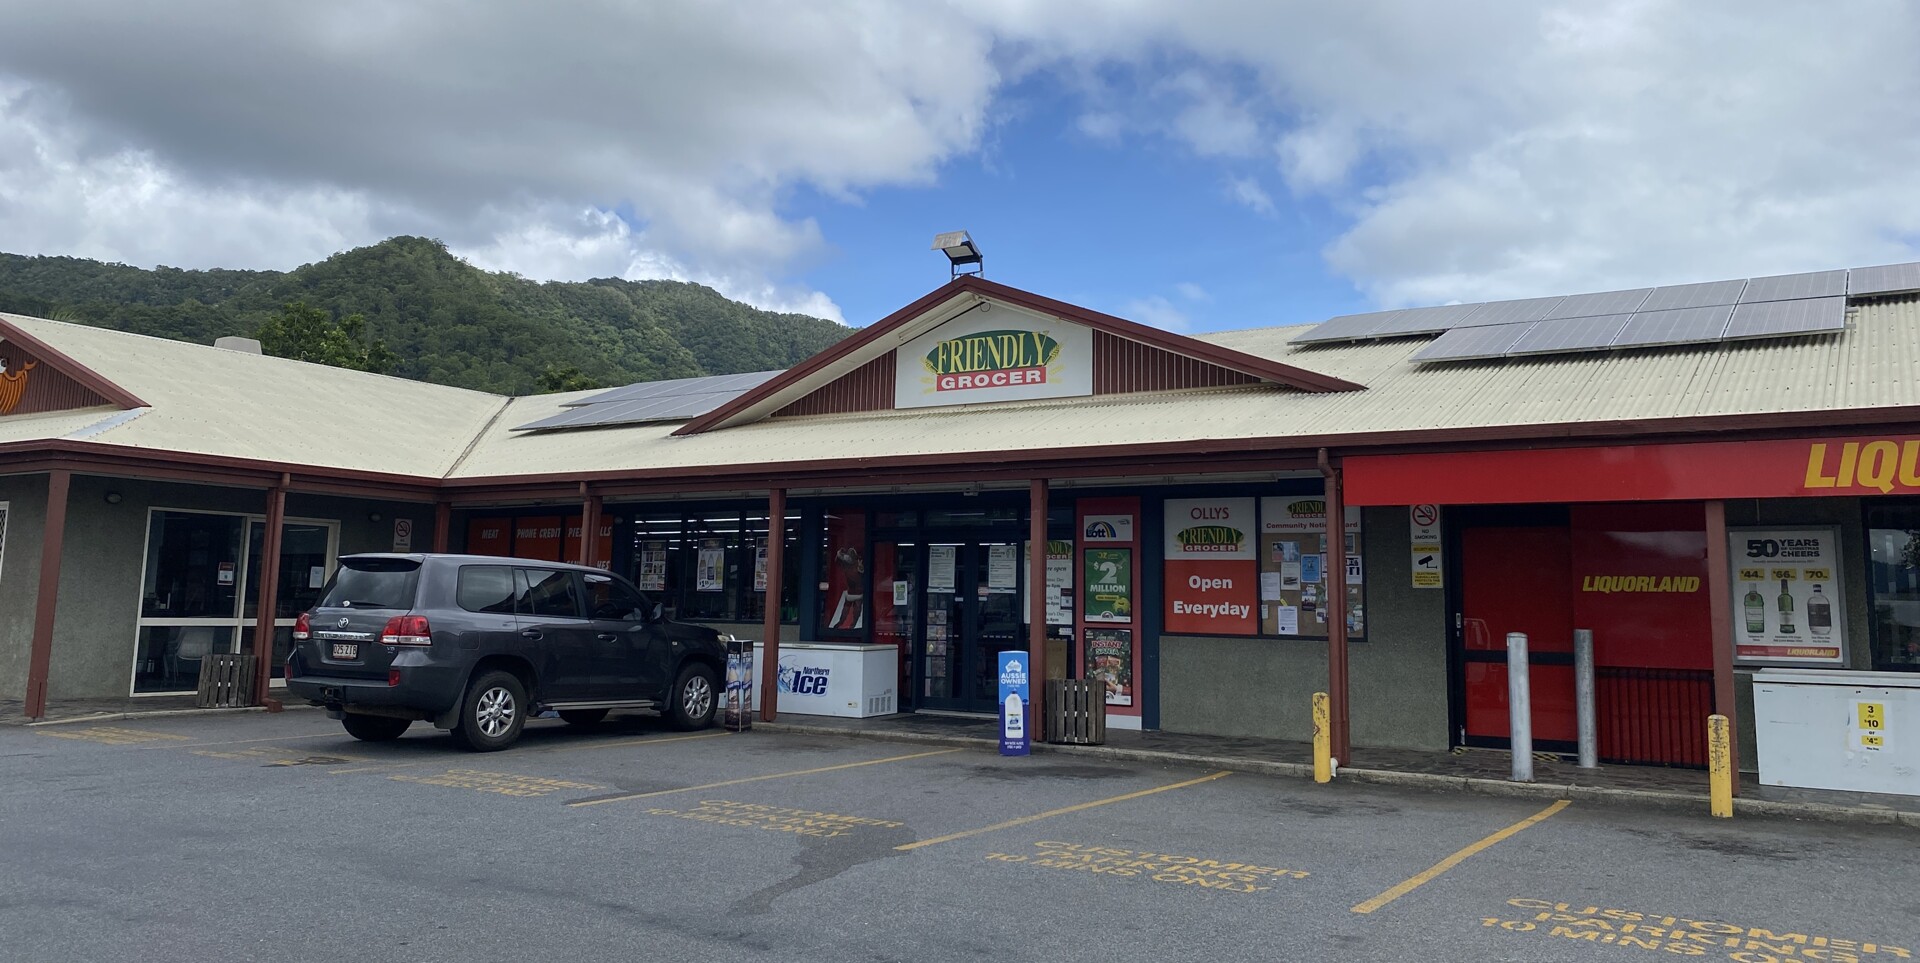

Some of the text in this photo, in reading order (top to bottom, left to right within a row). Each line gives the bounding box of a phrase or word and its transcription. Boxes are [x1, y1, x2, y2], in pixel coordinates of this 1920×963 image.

[937, 331, 1050, 374] FRIENDLY
[940, 370, 1041, 390] GROCER
[1804, 440, 1920, 494] LIQU
[1191, 507, 1229, 520] OLLYS
[1291, 501, 1326, 513] FRIENDL
[481, 528, 499, 539] MEAT
[516, 527, 561, 538] PHONE CREDIT
[567, 527, 583, 538] PIES
[1183, 527, 1238, 544] FRIENDLY
[1047, 542, 1070, 554] NDLY
[1746, 539, 1780, 557] 50
[1093, 561, 1118, 584] $2
[1090, 584, 1126, 593] MILLION
[1188, 575, 1233, 592] Open
[1582, 575, 1700, 594] LIQUORLAND
[1173, 600, 1250, 619] Everyday
[1786, 648, 1836, 656] LIQUORLAND
[802, 666, 830, 676] Northern
[791, 670, 828, 695] Ice
[1868, 705, 1874, 713] 3
[1034, 841, 1310, 879] CUSTOMER
[1037, 850, 1258, 882] PARKING
[1030, 859, 1141, 876] MINS
[1152, 873, 1272, 893] ONLY
[1480, 917, 1705, 955] 10 MINS
[1507, 898, 1911, 958] CUSTOMER
[1536, 912, 1859, 963] PARKING
